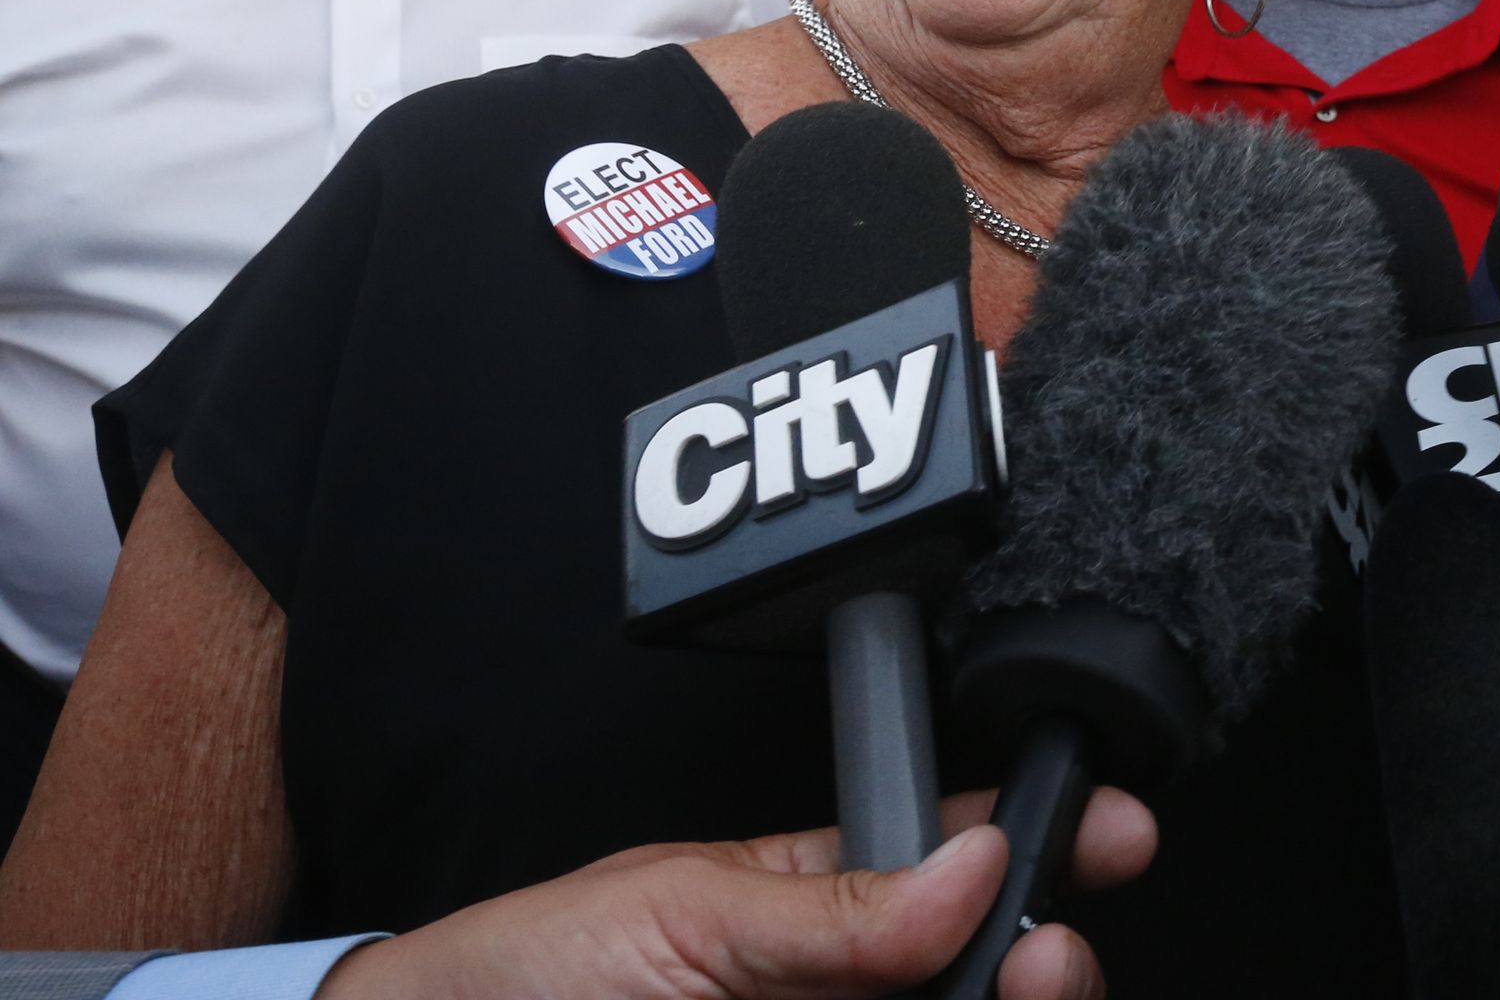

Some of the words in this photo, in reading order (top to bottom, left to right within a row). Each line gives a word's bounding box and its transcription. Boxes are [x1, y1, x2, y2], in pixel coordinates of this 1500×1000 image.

[552, 149, 663, 212] ELECT
[565, 171, 712, 254] MICHAEL
[625, 213, 716, 275] FORD
[634, 343, 939, 540] City
